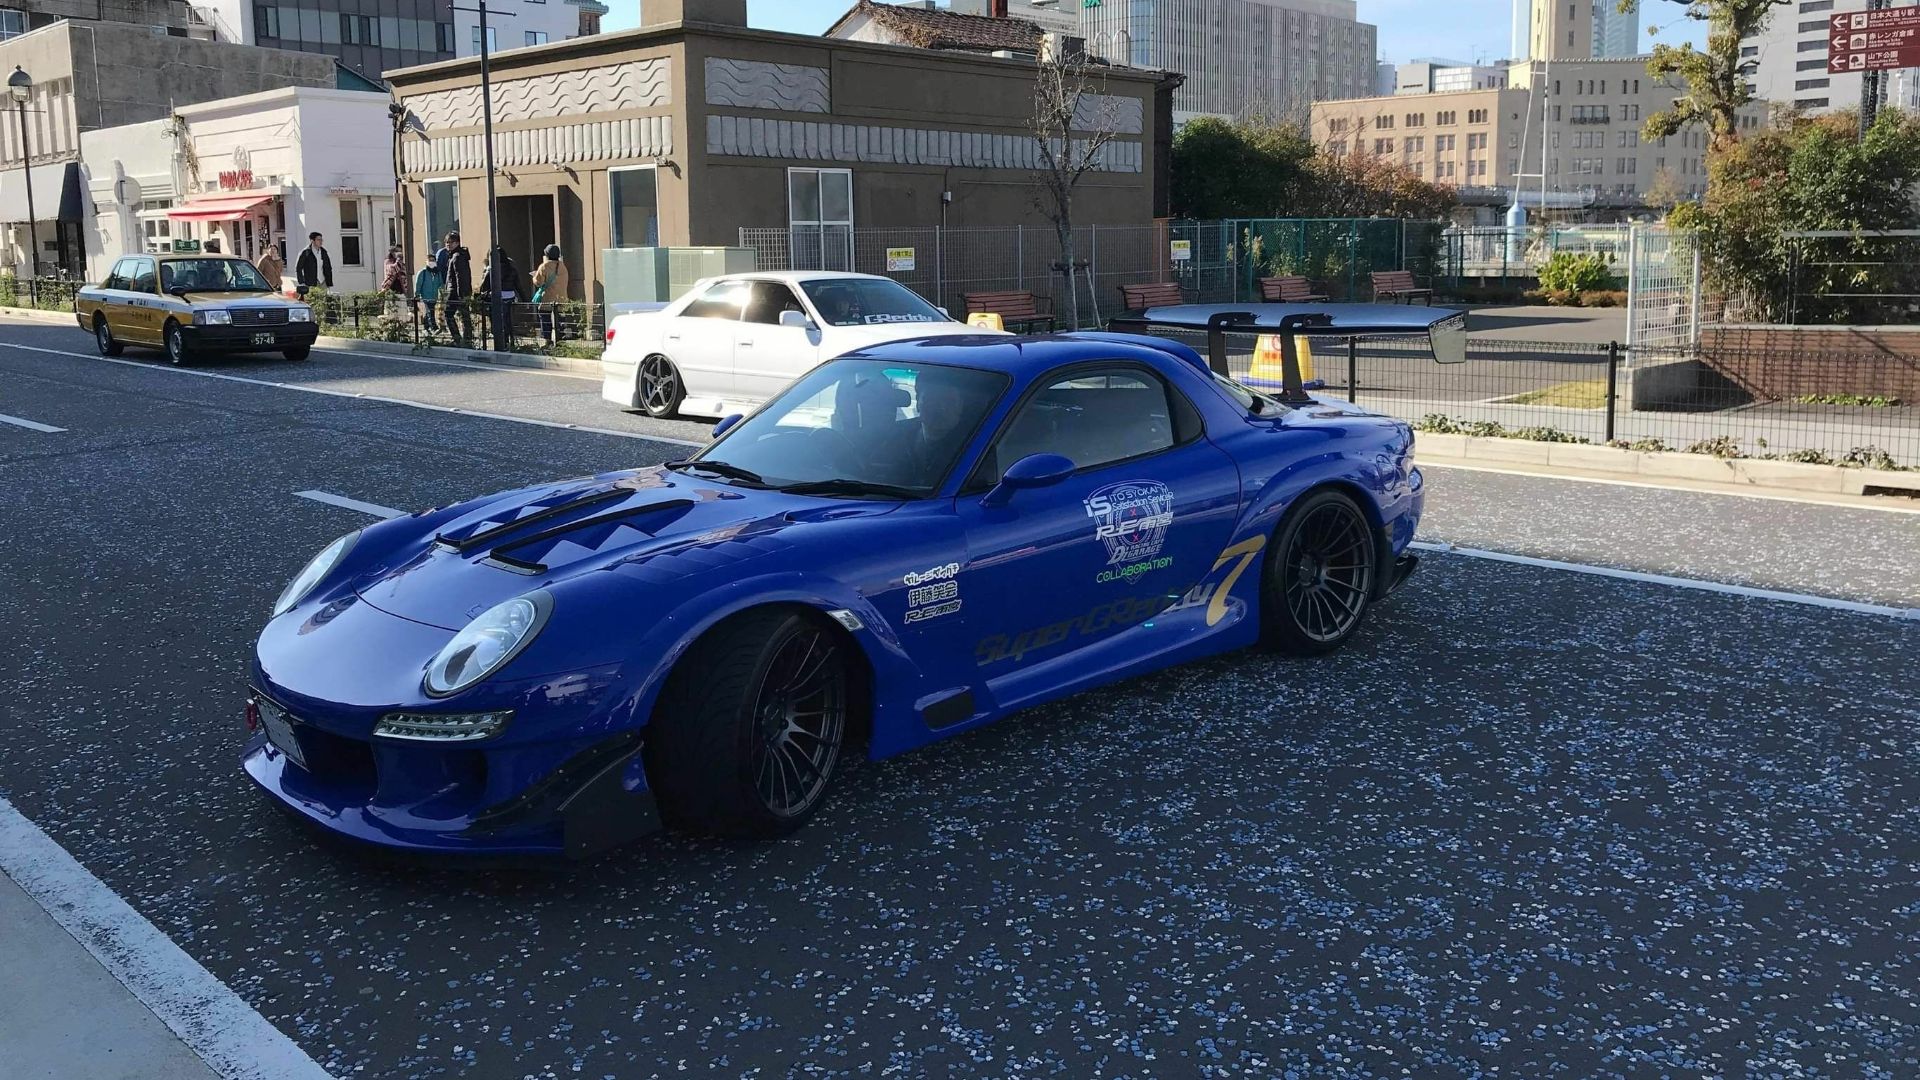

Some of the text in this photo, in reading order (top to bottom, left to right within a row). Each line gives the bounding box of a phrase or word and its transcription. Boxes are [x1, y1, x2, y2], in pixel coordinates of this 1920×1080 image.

[1870, 9, 1916, 20] 日本大通り駅
[1869, 29, 1915, 40] 赤レンガ倉庫
[1867, 51, 1899, 60] 山下公園
[864, 313, 933, 324] GReddy
[255, 336, 275, 345] 57-48
[1109, 492, 1125, 503] ITO
[1096, 556, 1174, 583] COLLABORATION
[1206, 534, 1267, 627] 7
